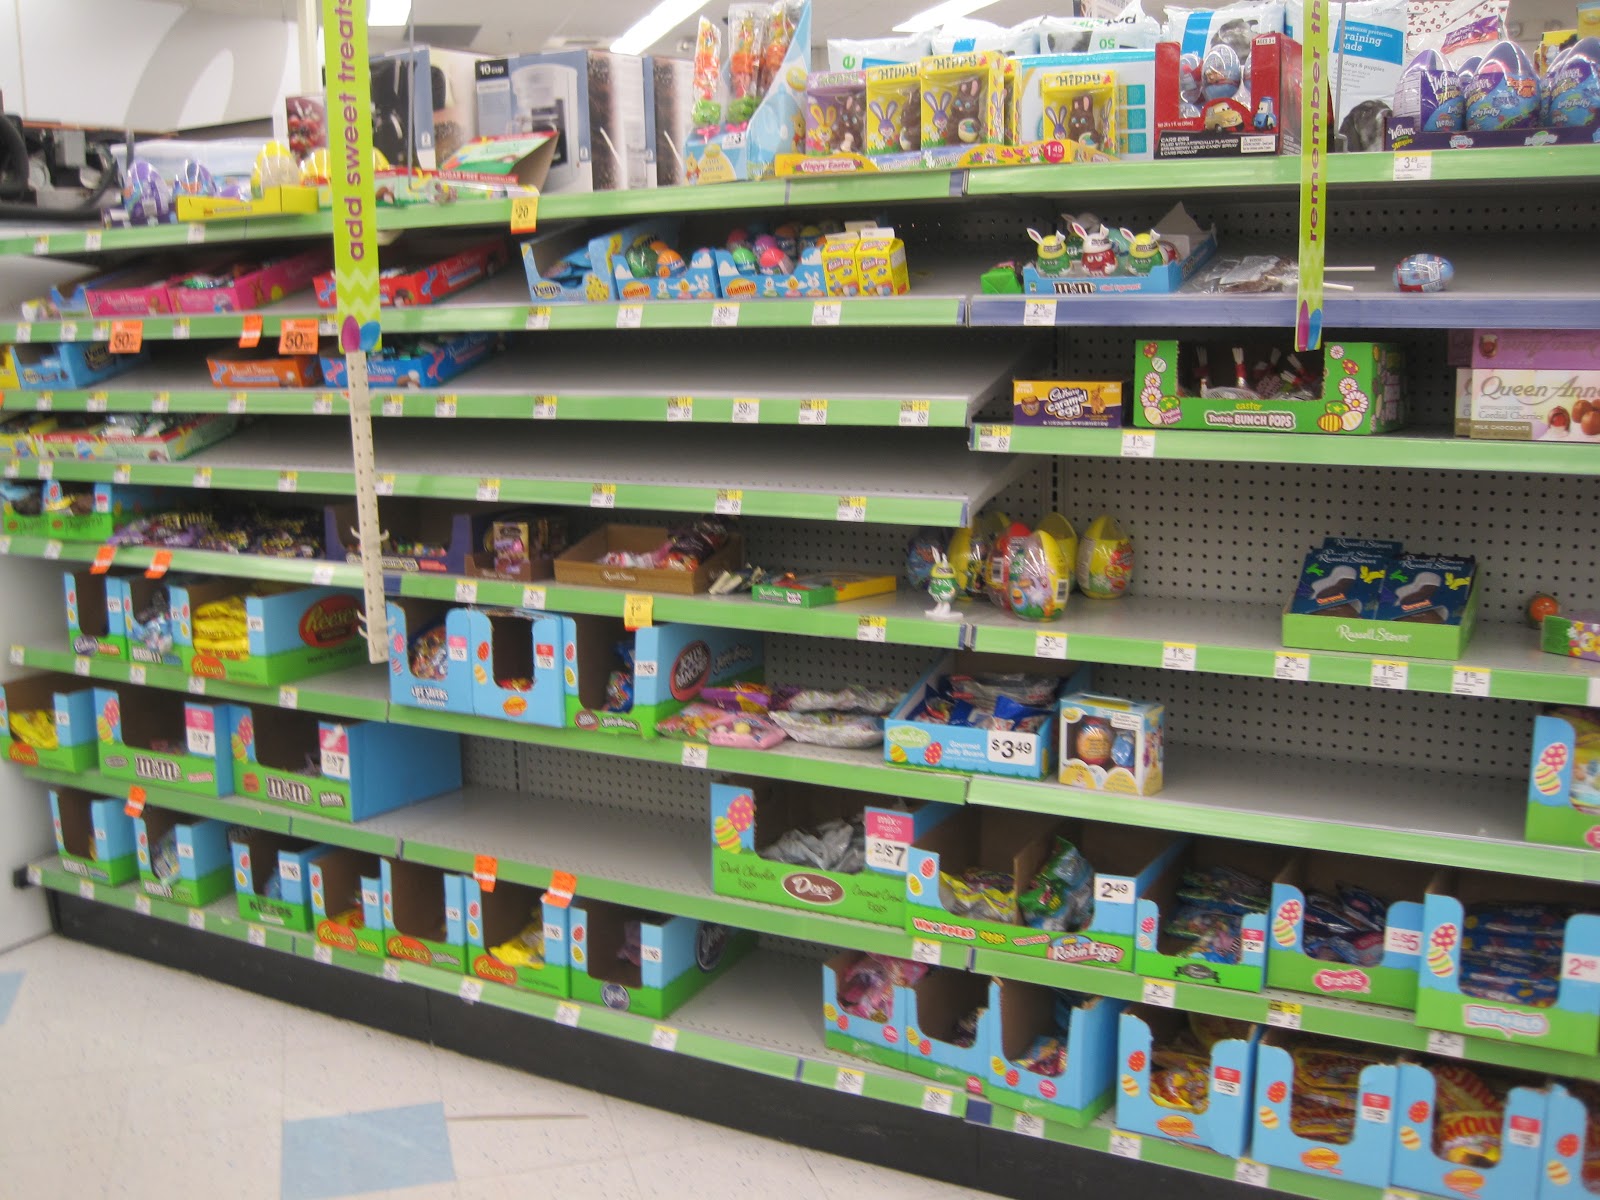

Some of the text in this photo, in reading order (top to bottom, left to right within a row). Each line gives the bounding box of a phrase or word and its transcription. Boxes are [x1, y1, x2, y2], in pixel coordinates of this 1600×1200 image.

[1339, 42, 1363, 52] ads
[1345, 33, 1382, 47] raining
[334, 0, 365, 261] add sweet treats
[1310, 46, 1321, 241] remember
[462, 171, 479, 181] FREE
[804, 161, 853, 173] Happy Easter
[1481, 376, 1548, 400] Queen
[1047, 390, 1088, 412] caramel
[1057, 403, 1081, 417] egg
[1234, 414, 1267, 426] BUNCH
[1268, 415, 1292, 428] POPS
[1337, 624, 1411, 643] Russell Stover
[791, 875, 834, 901] Dove
[913, 918, 977, 940] WHOPPERS
[1053, 942, 1119, 963] Robin Eggs
[1320, 973, 1364, 988] Brach's
